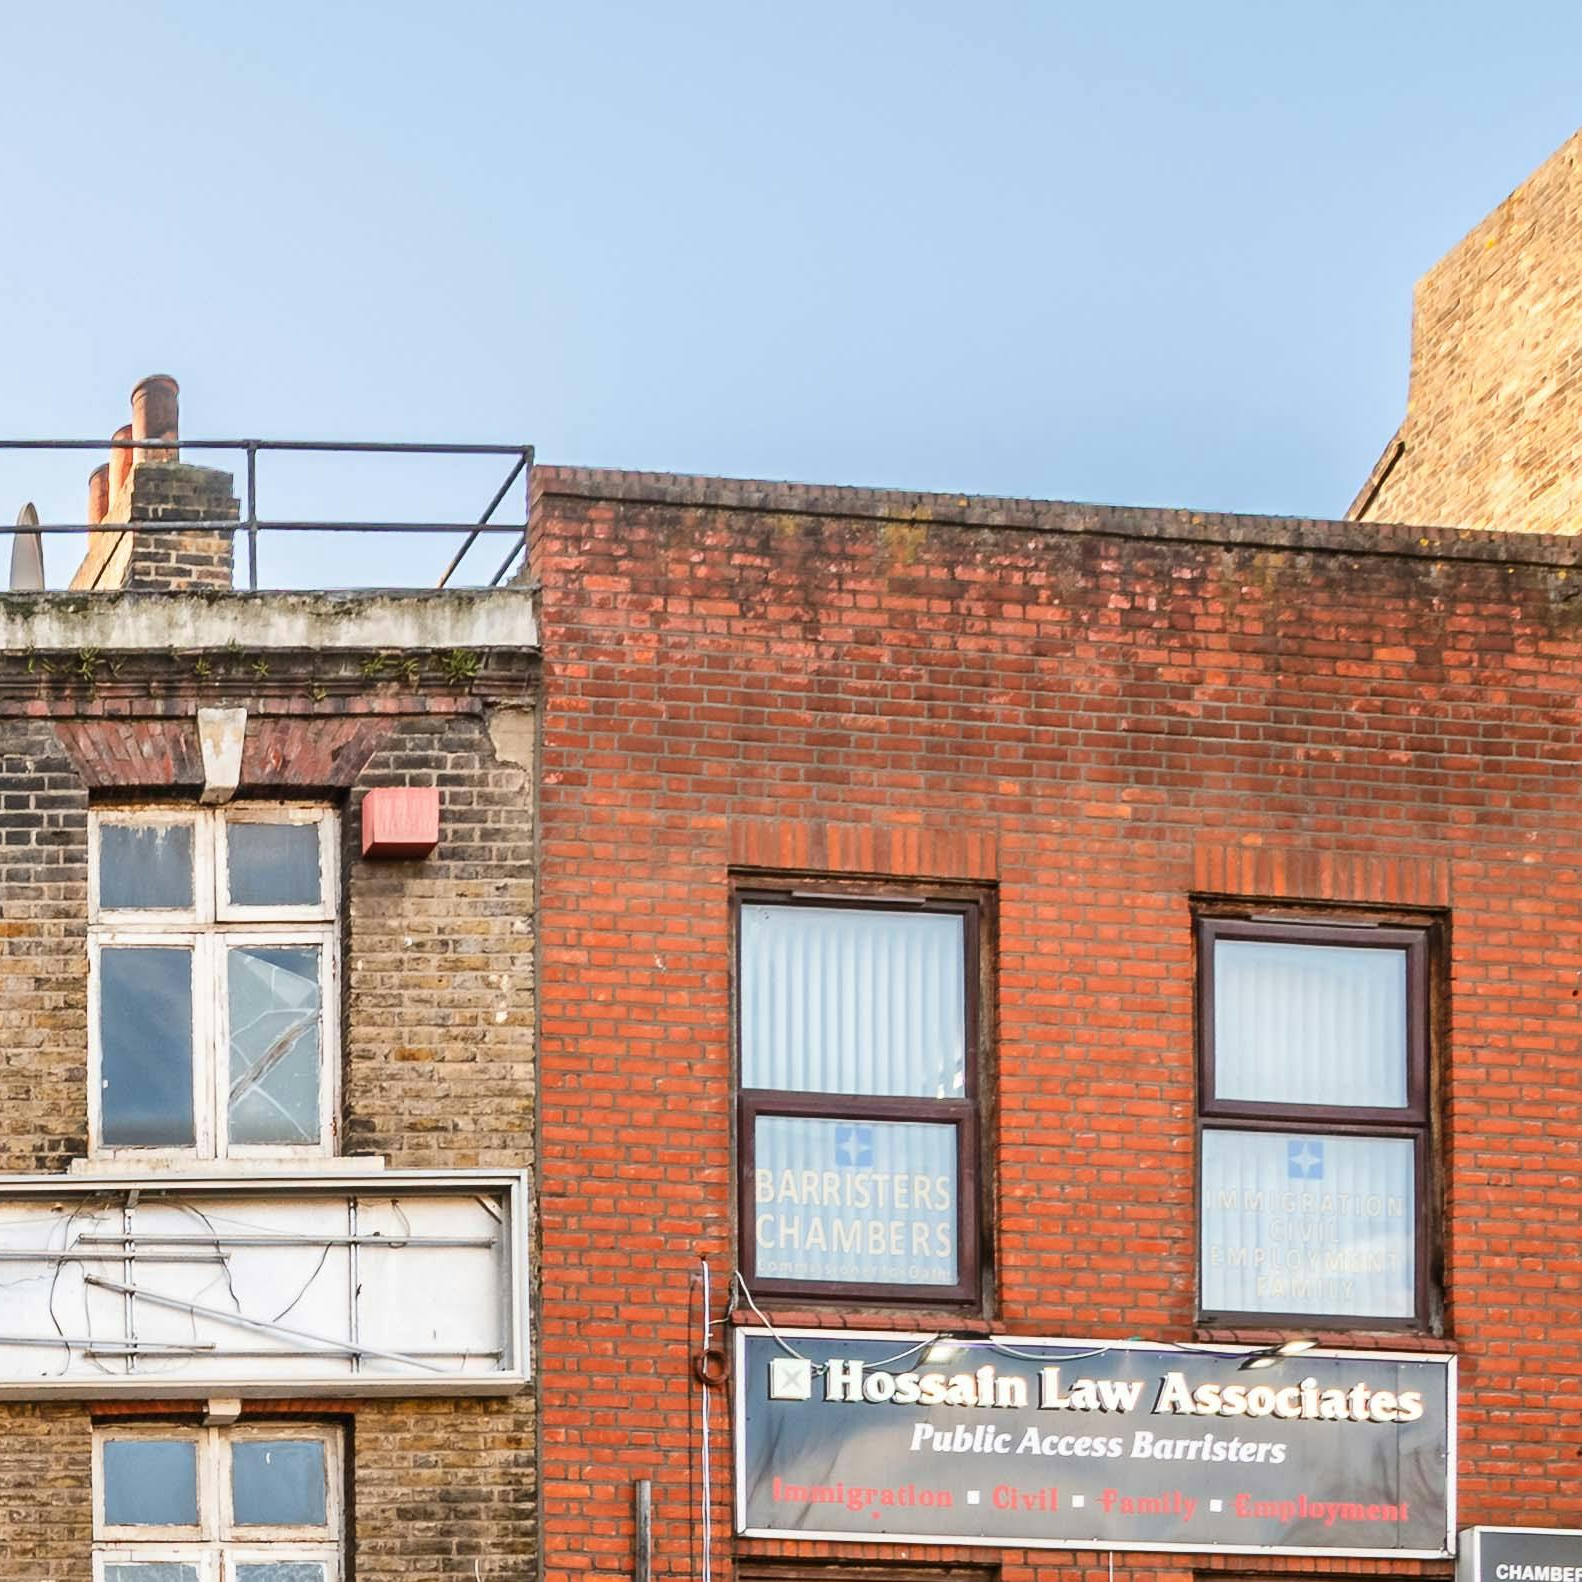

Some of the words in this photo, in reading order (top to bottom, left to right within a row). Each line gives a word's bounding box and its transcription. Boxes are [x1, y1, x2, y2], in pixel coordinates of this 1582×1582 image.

[755, 1168, 951, 1212] BARRISTERS
[1203, 1190, 1405, 1217] IMMIGRATION
[755, 1213, 952, 1258] CHAMBERS
[1269, 1217, 1340, 1244] CIVIL
[1210, 1246, 1398, 1273] EMPLOYMENT
[1257, 1275, 1354, 1298] FAMILY
[824, 1357, 1029, 1409] Hossain
[1038, 1366, 1143, 1412] Law
[1151, 1371, 1424, 1423] Associates
[910, 1423, 1012, 1454] Public
[1016, 1426, 1124, 1458] Access
[1130, 1430, 1287, 1464] Barristers
[772, 1476, 954, 1512] Immigration
[992, 1484, 1059, 1512] Civil
[1095, 1488, 1197, 1522] Family
[1230, 1493, 1409, 1527] Employment
